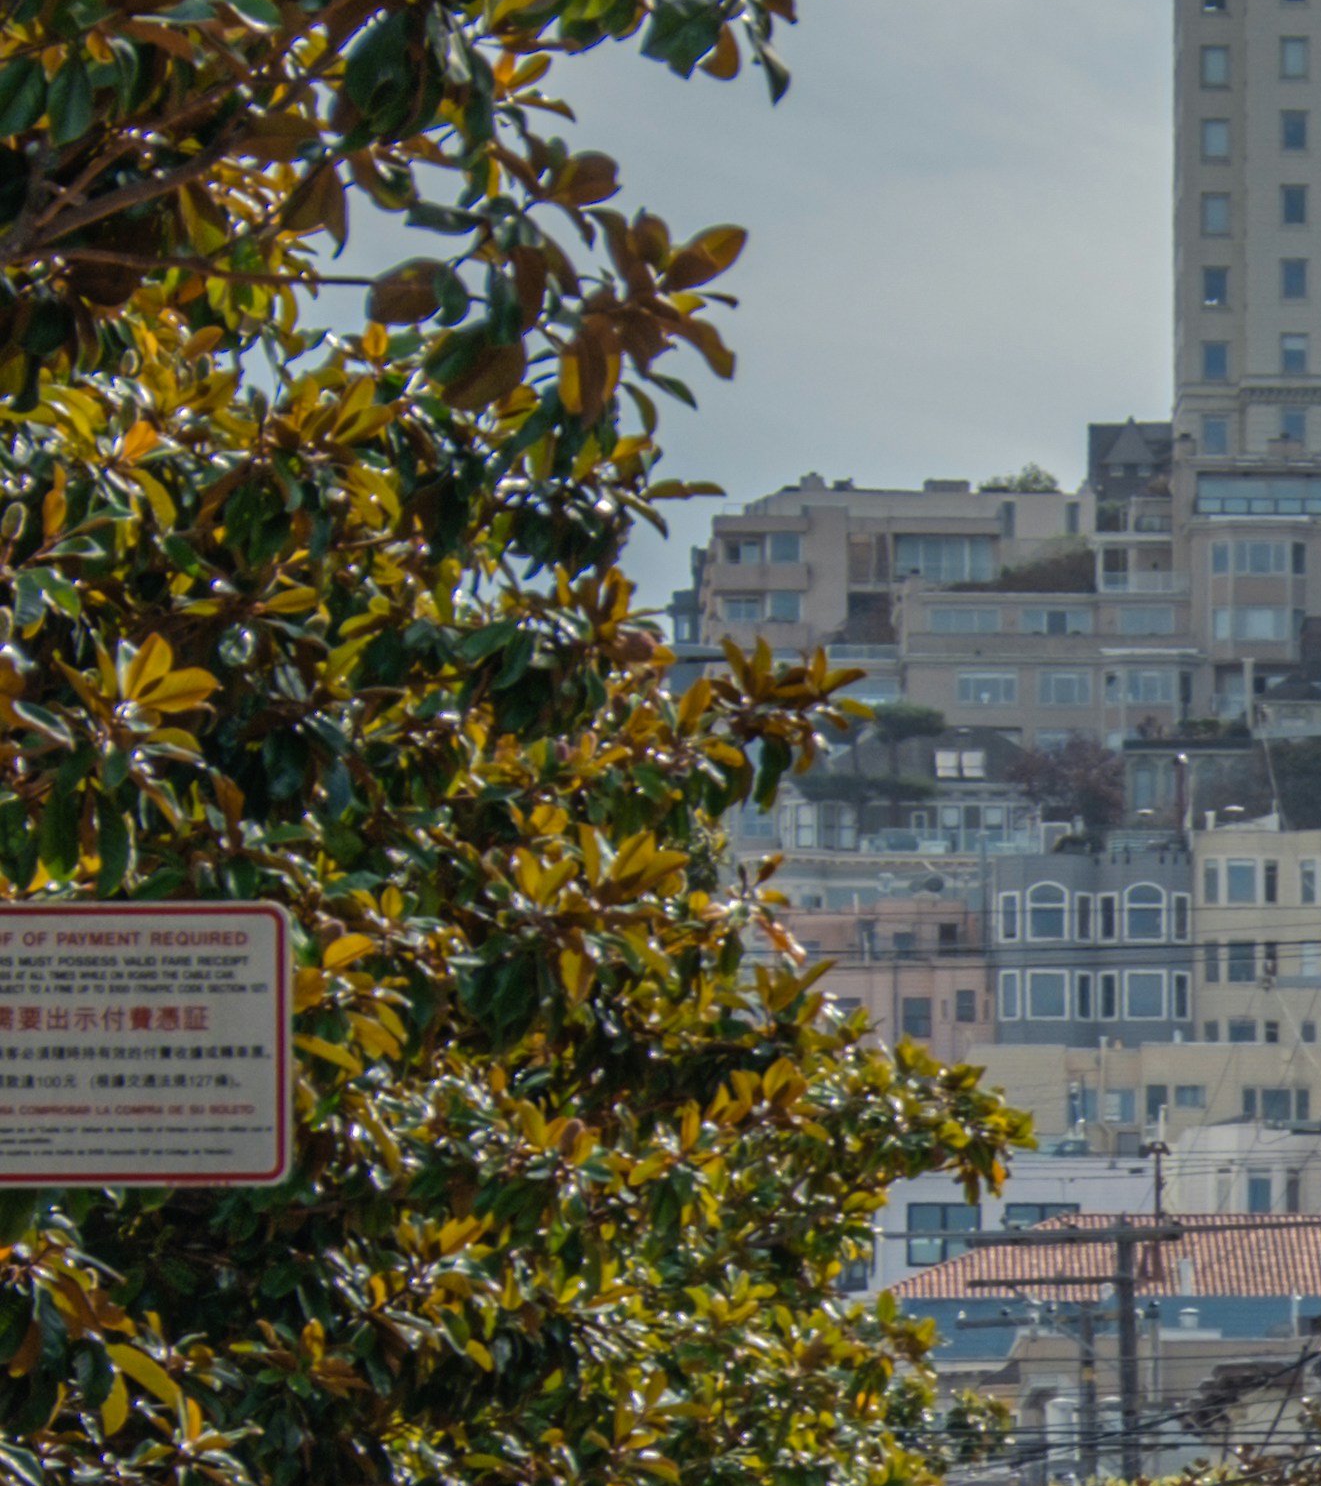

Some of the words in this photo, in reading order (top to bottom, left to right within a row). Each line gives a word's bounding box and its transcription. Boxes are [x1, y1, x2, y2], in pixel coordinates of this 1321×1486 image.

[22, 931, 47, 946] OF
[56, 931, 141, 946] PAYMENT
[150, 930, 248, 946] REQUIRED
